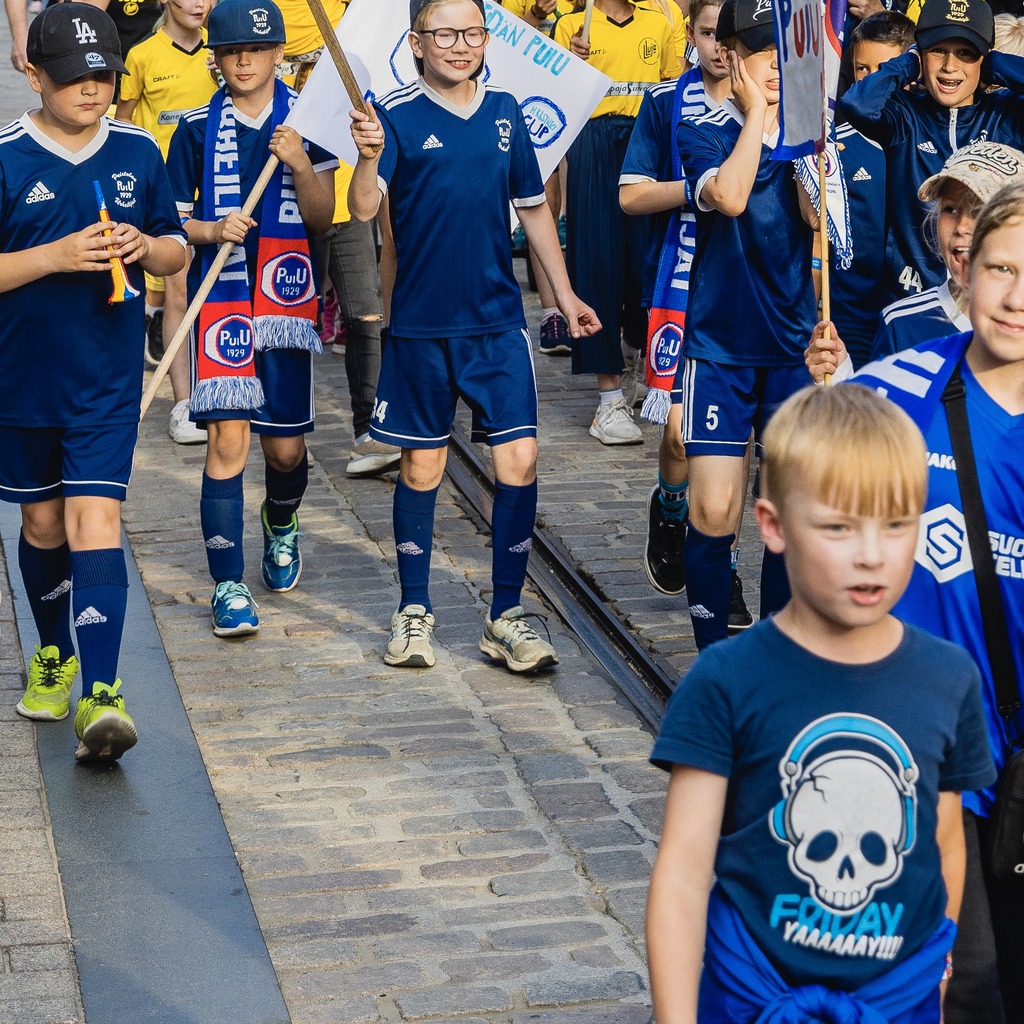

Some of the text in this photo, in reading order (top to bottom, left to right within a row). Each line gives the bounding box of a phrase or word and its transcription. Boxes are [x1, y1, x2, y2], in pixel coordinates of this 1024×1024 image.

[72, 18, 97, 44] LA
[523, 34, 571, 77] PUIU
[153, 74, 175, 83] CRAFT
[523, 115, 550, 139] CUP
[117, 181, 134, 192] PuiU
[26, 191, 55, 204] adidas
[276, 267, 307, 284] PuiU
[899, 266, 923, 293] 44
[282, 286, 300, 296] 1929
[220, 329, 250, 346] PuiU
[657, 336, 679, 356] PuiU
[226, 348, 245, 357] 1929
[706, 405, 719, 431] 5
[75, 612, 108, 627] adidas
[769, 894, 904, 940] FRIDAY
